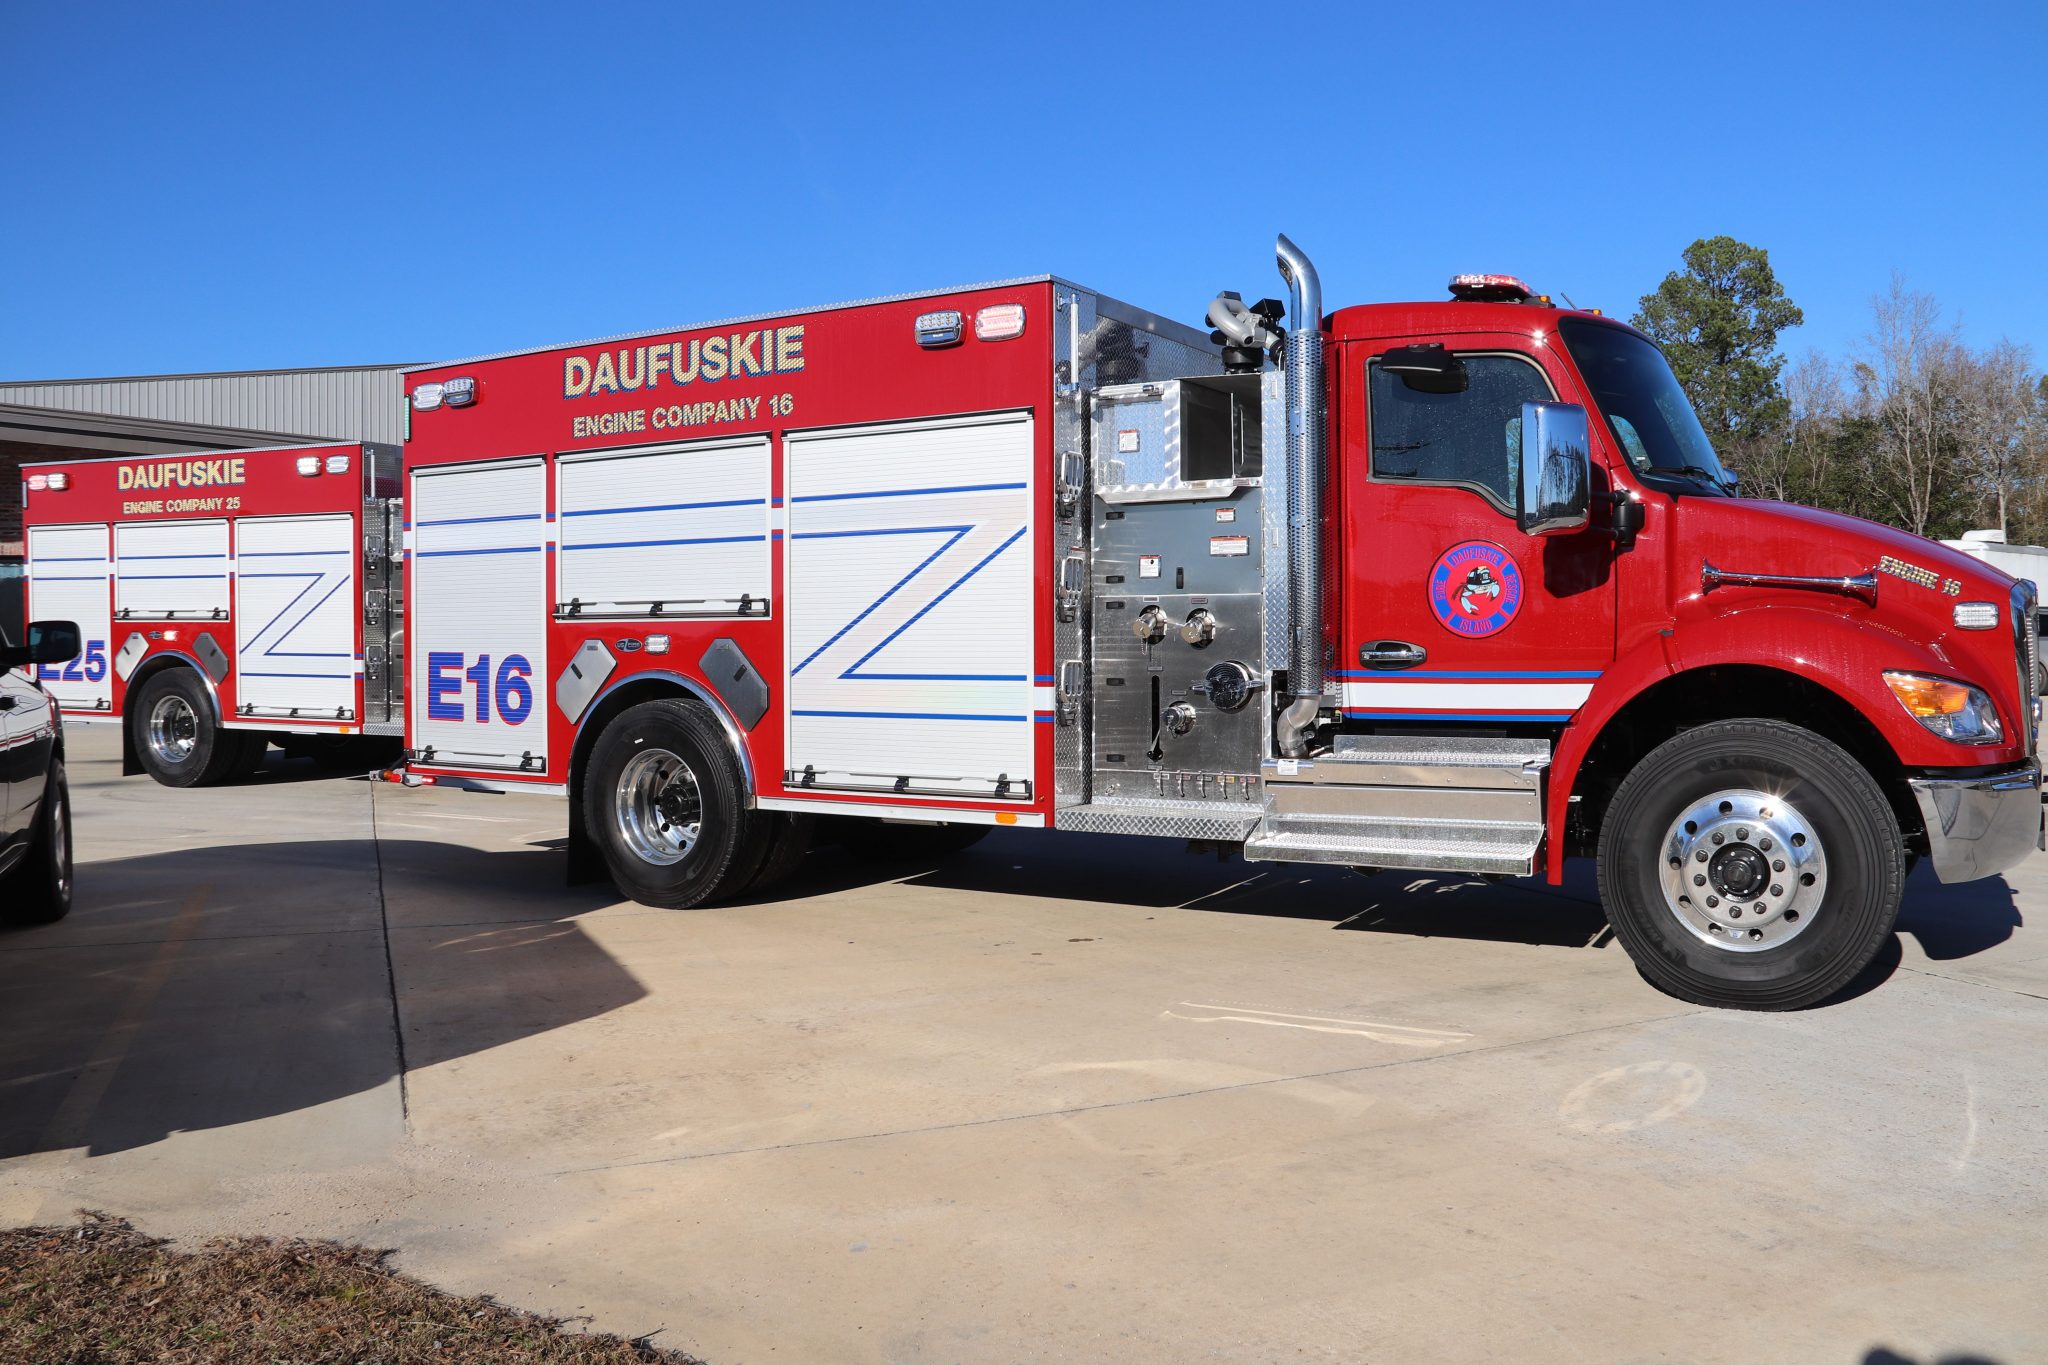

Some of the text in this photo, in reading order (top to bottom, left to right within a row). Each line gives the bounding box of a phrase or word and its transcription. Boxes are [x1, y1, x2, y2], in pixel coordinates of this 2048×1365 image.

[564, 325, 805, 400] DAUFUSKIE
[573, 393, 794, 438] ENGINE COMPANY 16
[118, 458, 246, 491] DAUFUSKIE
[123, 496, 241, 515] ENGINE COMPANY 25
[1451, 547, 1500, 567] DAUFUSKIE
[1880, 555, 1962, 597] ENGINE 16
[1459, 617, 1493, 632] ISLAND
[428, 651, 533, 726] E16
